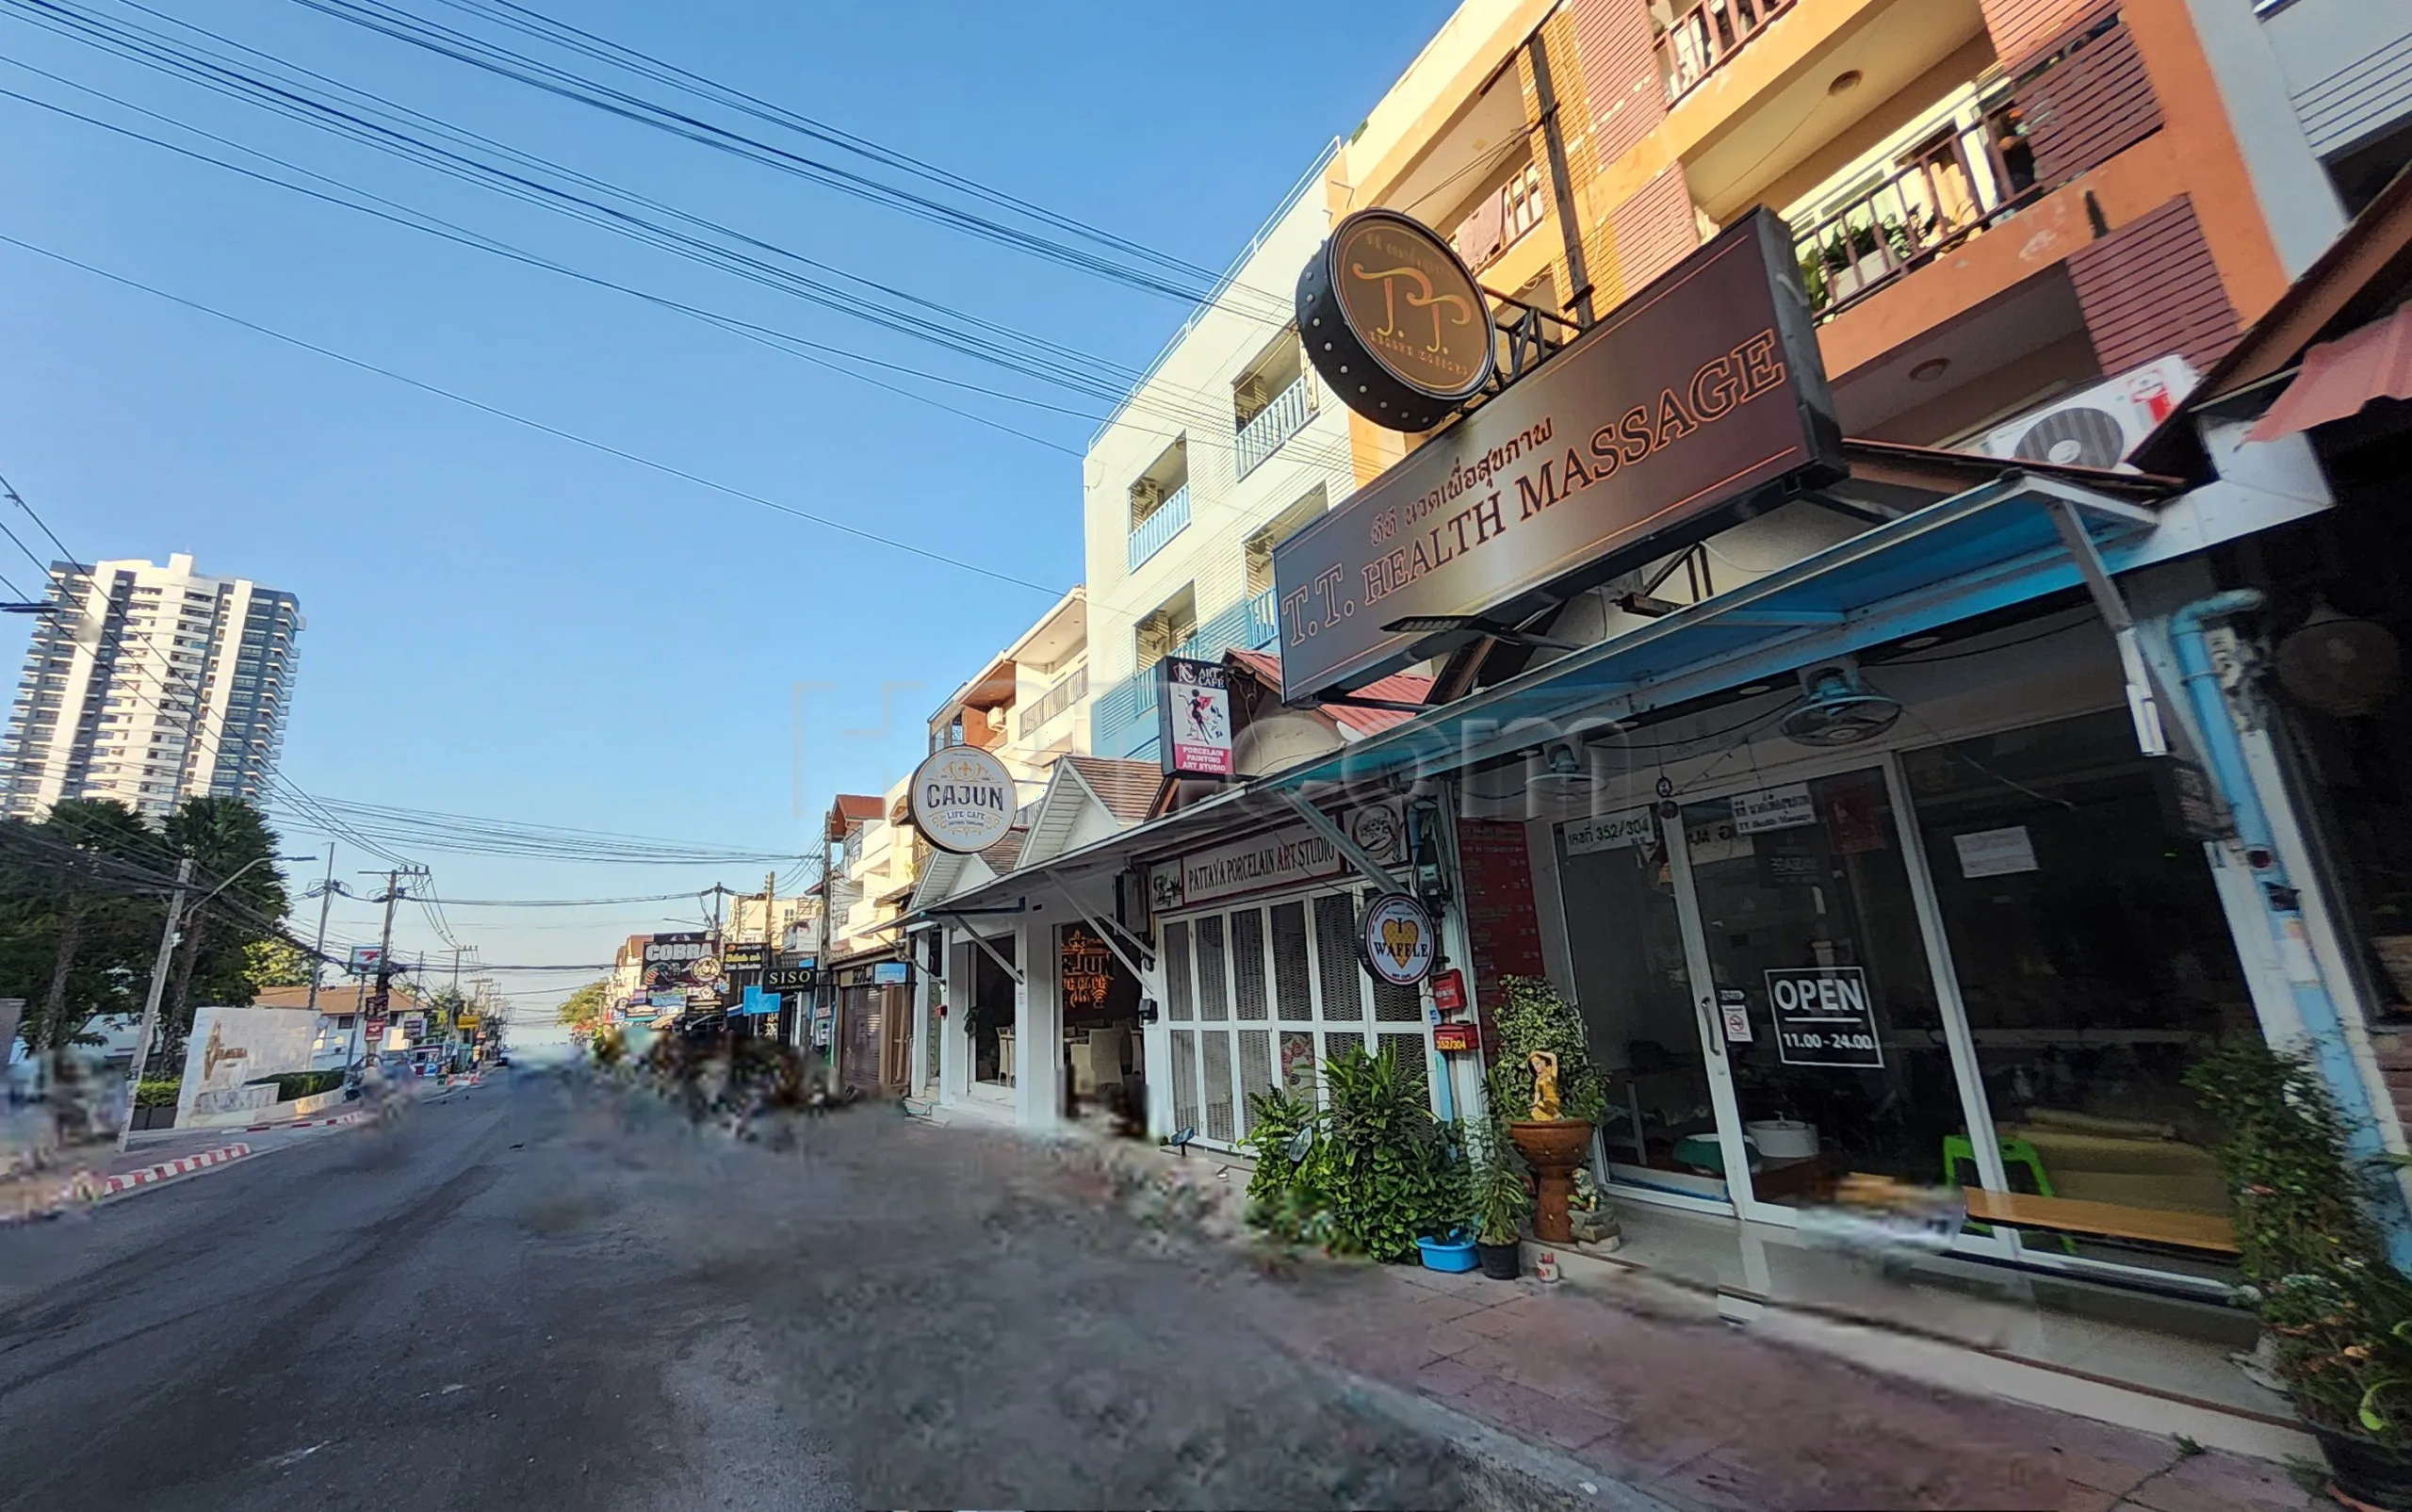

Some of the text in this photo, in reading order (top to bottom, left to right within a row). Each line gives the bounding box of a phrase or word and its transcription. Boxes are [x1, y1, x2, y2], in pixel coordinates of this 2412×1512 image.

[1404, 416, 1554, 528] นวดเพื่อสุขภาพ
[1282, 563, 1355, 646] T.T.
[1362, 490, 1507, 607] HEALTH
[1514, 328, 1786, 523] MASSAGE
[1198, 667, 1224, 678] ART
[1182, 746, 1225, 757] PORCELAIN
[1186, 754, 1222, 765] PAINTING
[1182, 761, 1226, 772] ART STUDIO
[927, 784, 1003, 812] CAJUN
[946, 810, 986, 821] LIFE CAFE
[1568, 817, 1650, 845] เลขที่ 352/304
[1188, 836, 1335, 892] PATTAYA PORCELAIN ART STUDIO
[645, 942, 713, 962] COBRA
[1374, 942, 1428, 959] WAFFLE
[769, 969, 811, 985] SISO
[1774, 978, 1866, 1011] OPEN
[1436, 1039, 1467, 1049] 352/304
